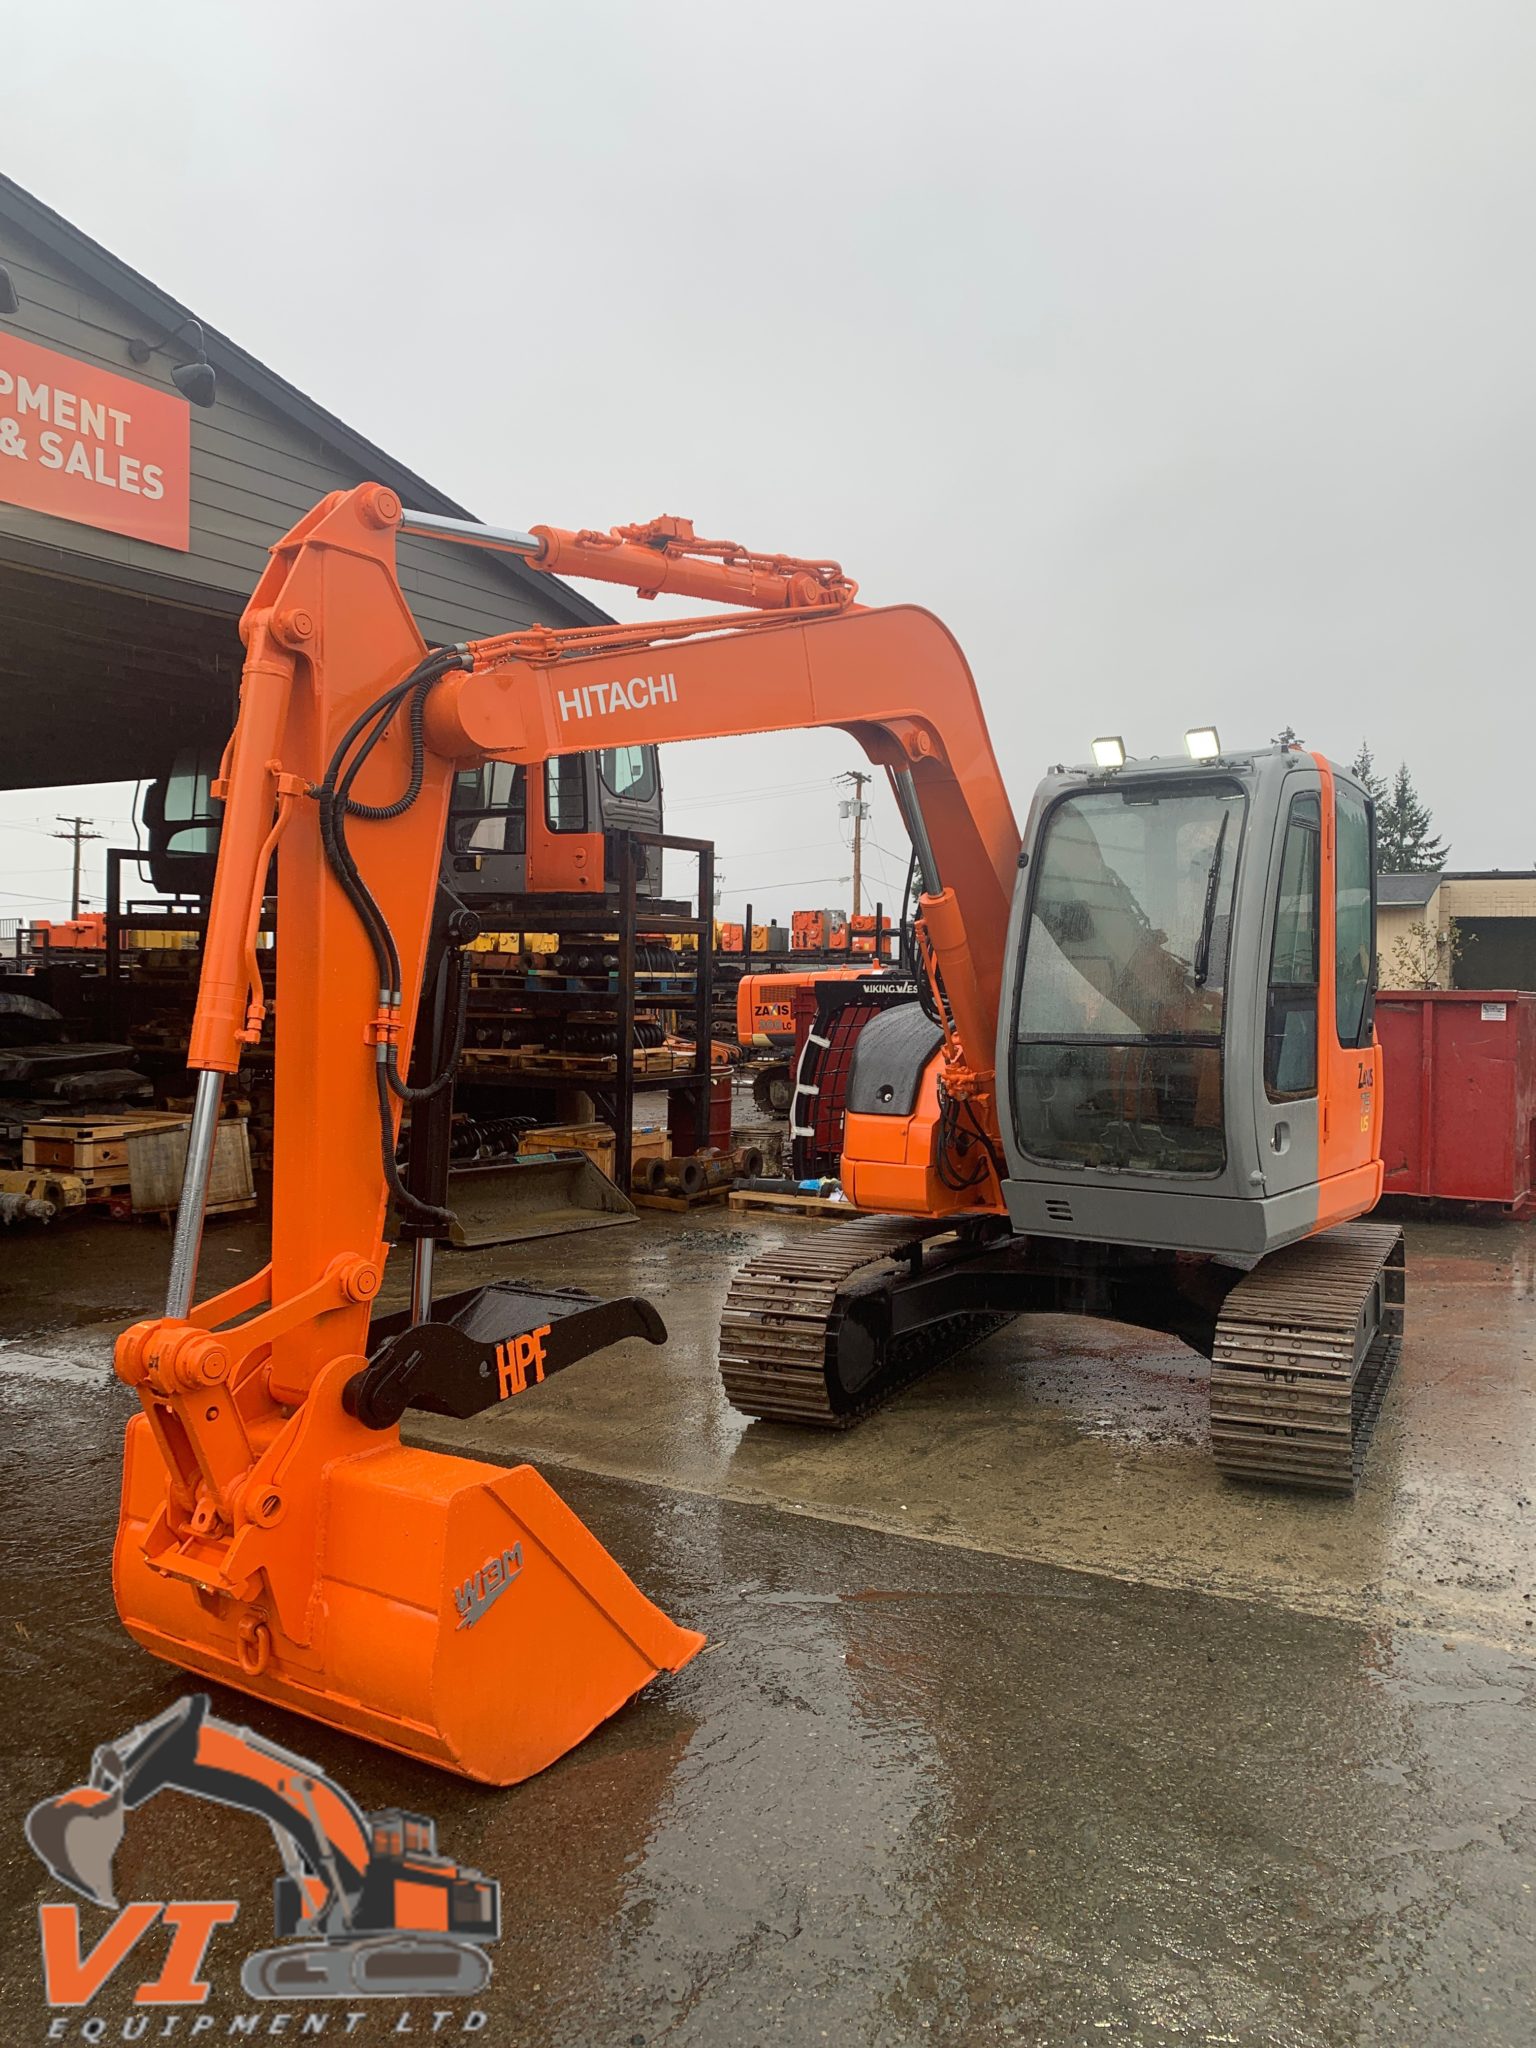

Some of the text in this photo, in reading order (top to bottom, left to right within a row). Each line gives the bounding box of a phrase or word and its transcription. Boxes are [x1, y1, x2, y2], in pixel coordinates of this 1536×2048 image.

[0, 418, 164, 500] & SALES
[557, 673, 678, 722] HITACHI
[755, 1002, 789, 1016] ZAXIS
[495, 1324, 551, 1400] HPF
